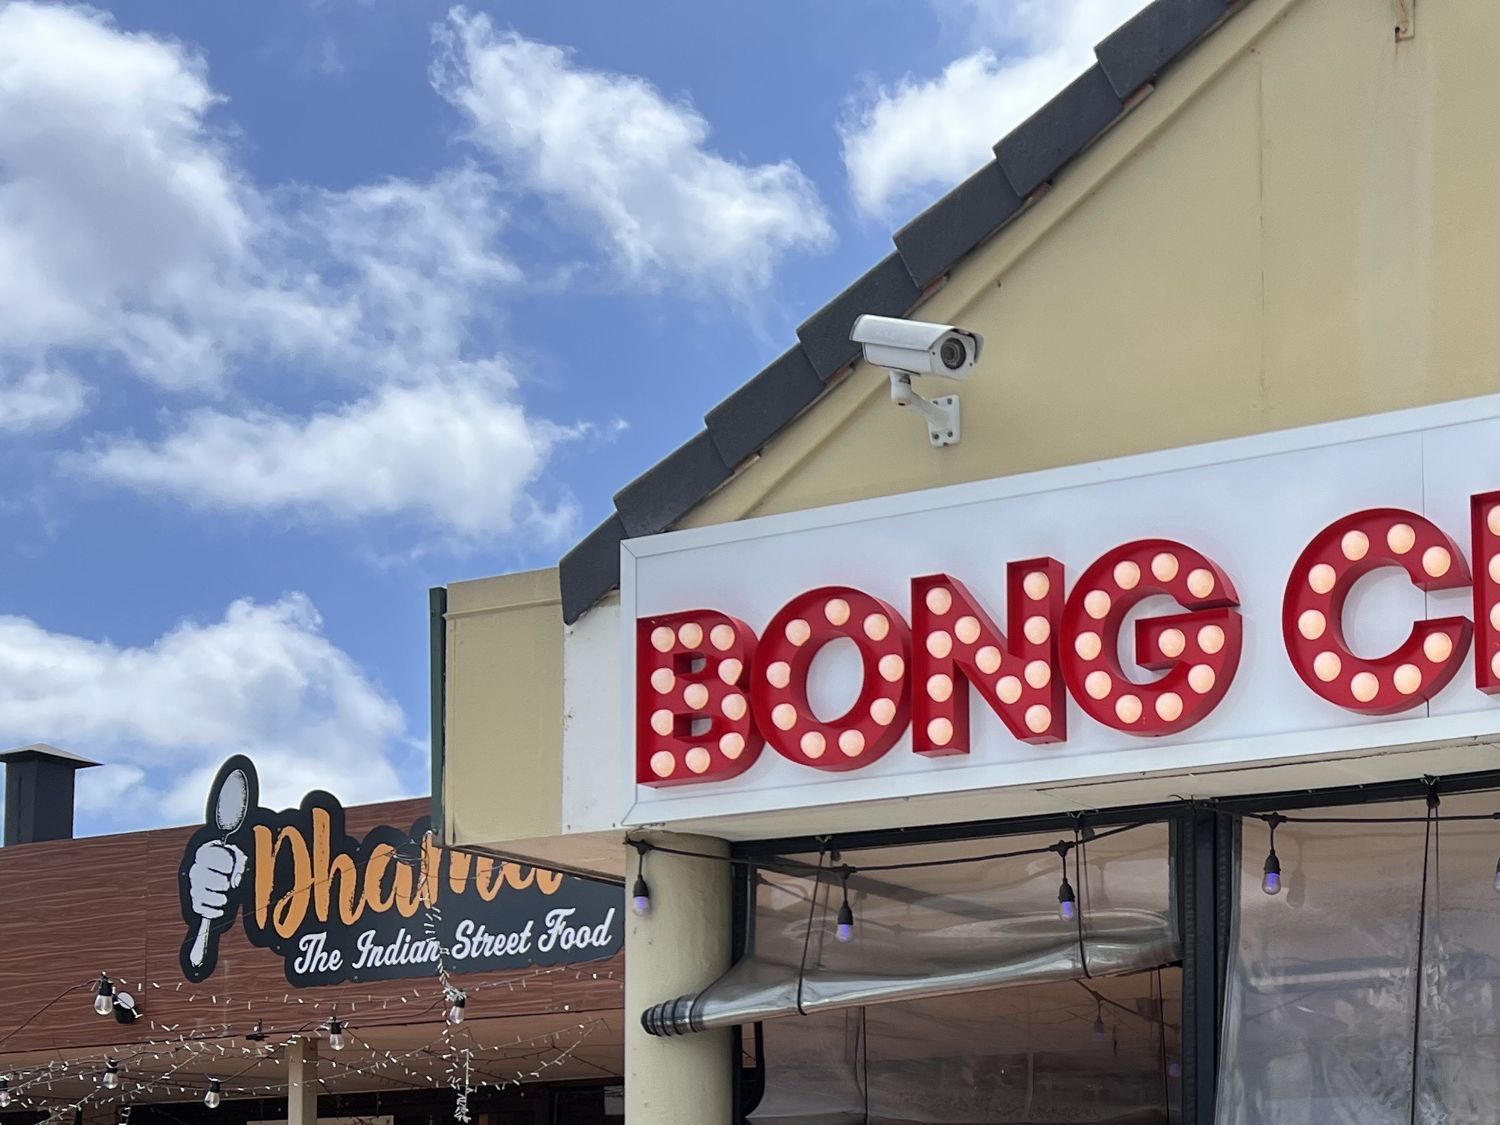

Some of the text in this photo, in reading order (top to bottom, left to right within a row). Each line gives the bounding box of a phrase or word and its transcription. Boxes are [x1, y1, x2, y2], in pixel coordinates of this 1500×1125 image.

[636, 539, 1243, 789] BONG
[294, 907, 615, 974] The Indian Street Food
